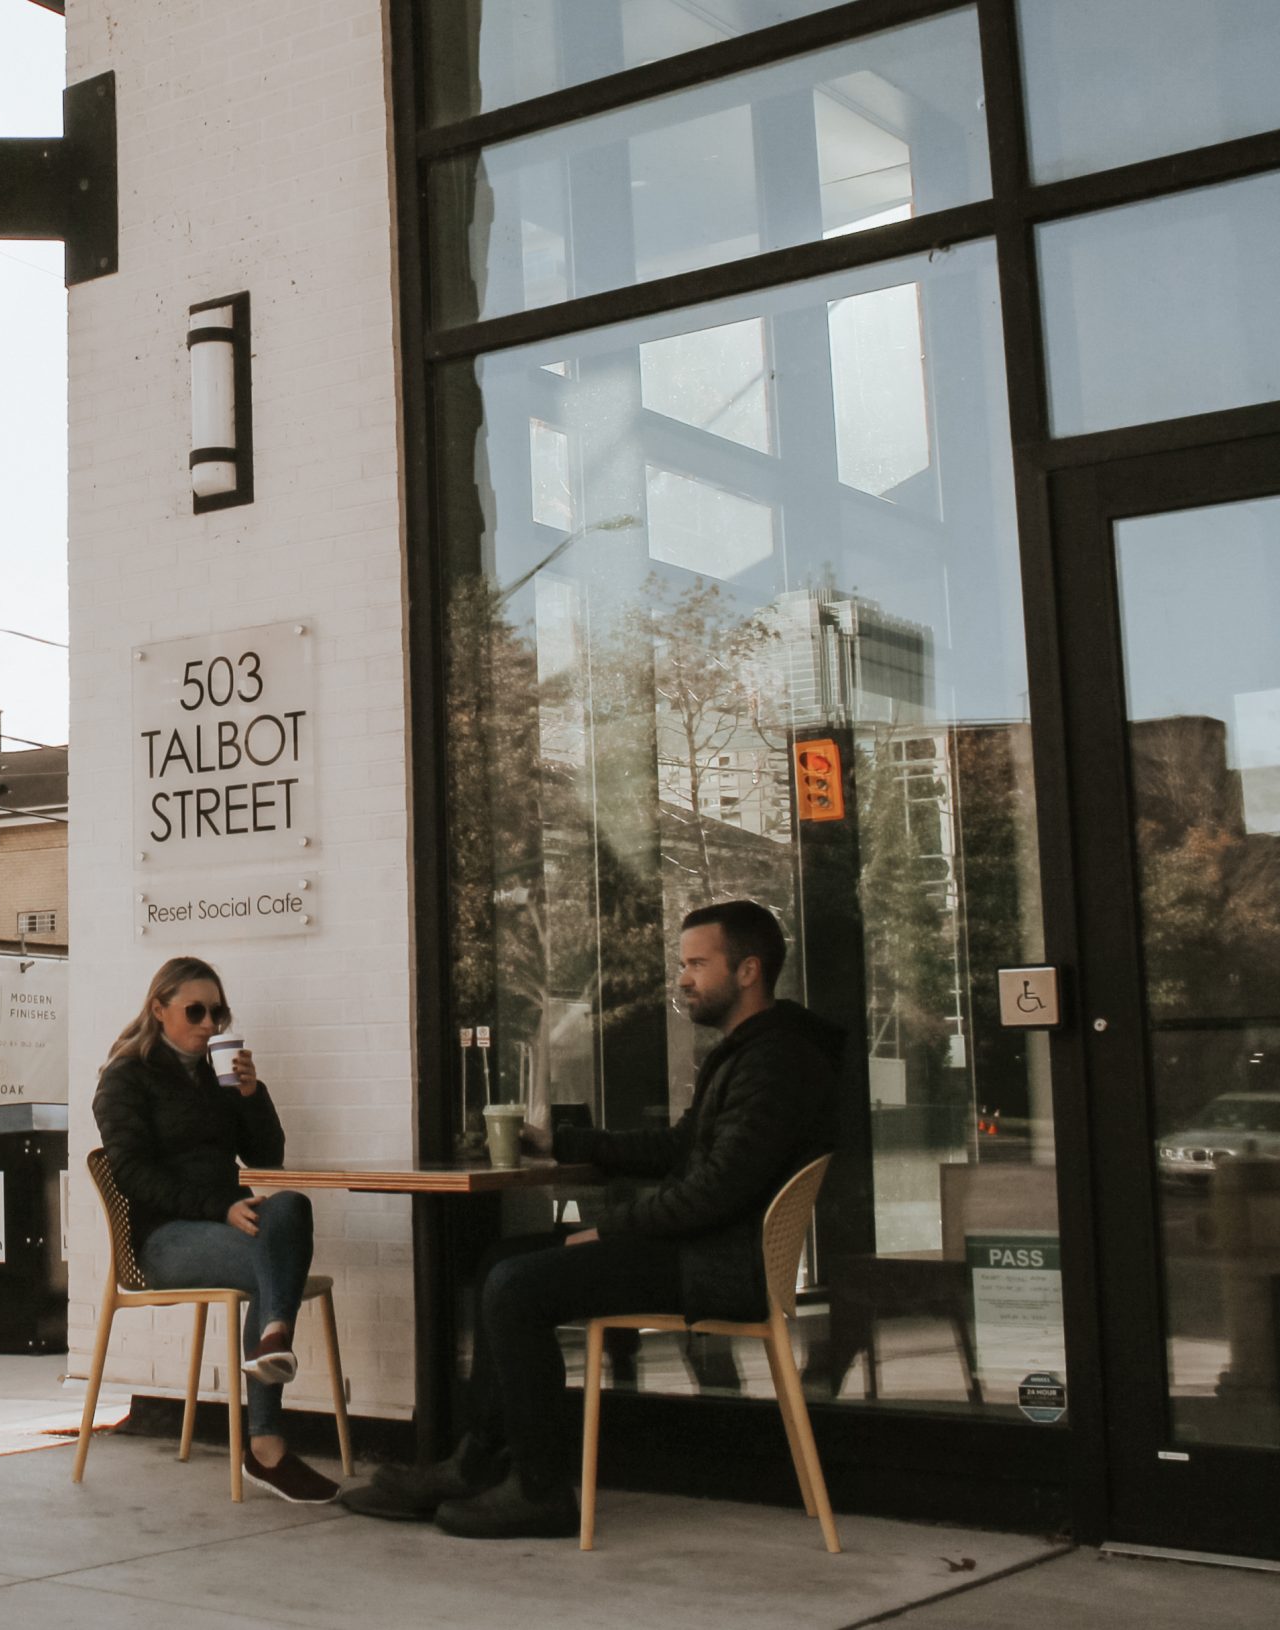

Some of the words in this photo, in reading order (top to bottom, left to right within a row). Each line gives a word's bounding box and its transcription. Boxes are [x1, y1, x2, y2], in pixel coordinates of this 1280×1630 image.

[180, 651, 263, 711] 503
[141, 710, 307, 779] TALBOT
[150, 778, 299, 842] STREET
[147, 901, 193, 923] Reset
[198, 897, 251, 920] Social
[257, 893, 303, 916] Cafe
[10, 993, 52, 1005] MODERN
[10, 1008, 57, 1020] FINISHES
[0, 1084, 25, 1096] OAK
[989, 1249, 1044, 1267] PASS
[1036, 1389, 1057, 1397] HOUR
